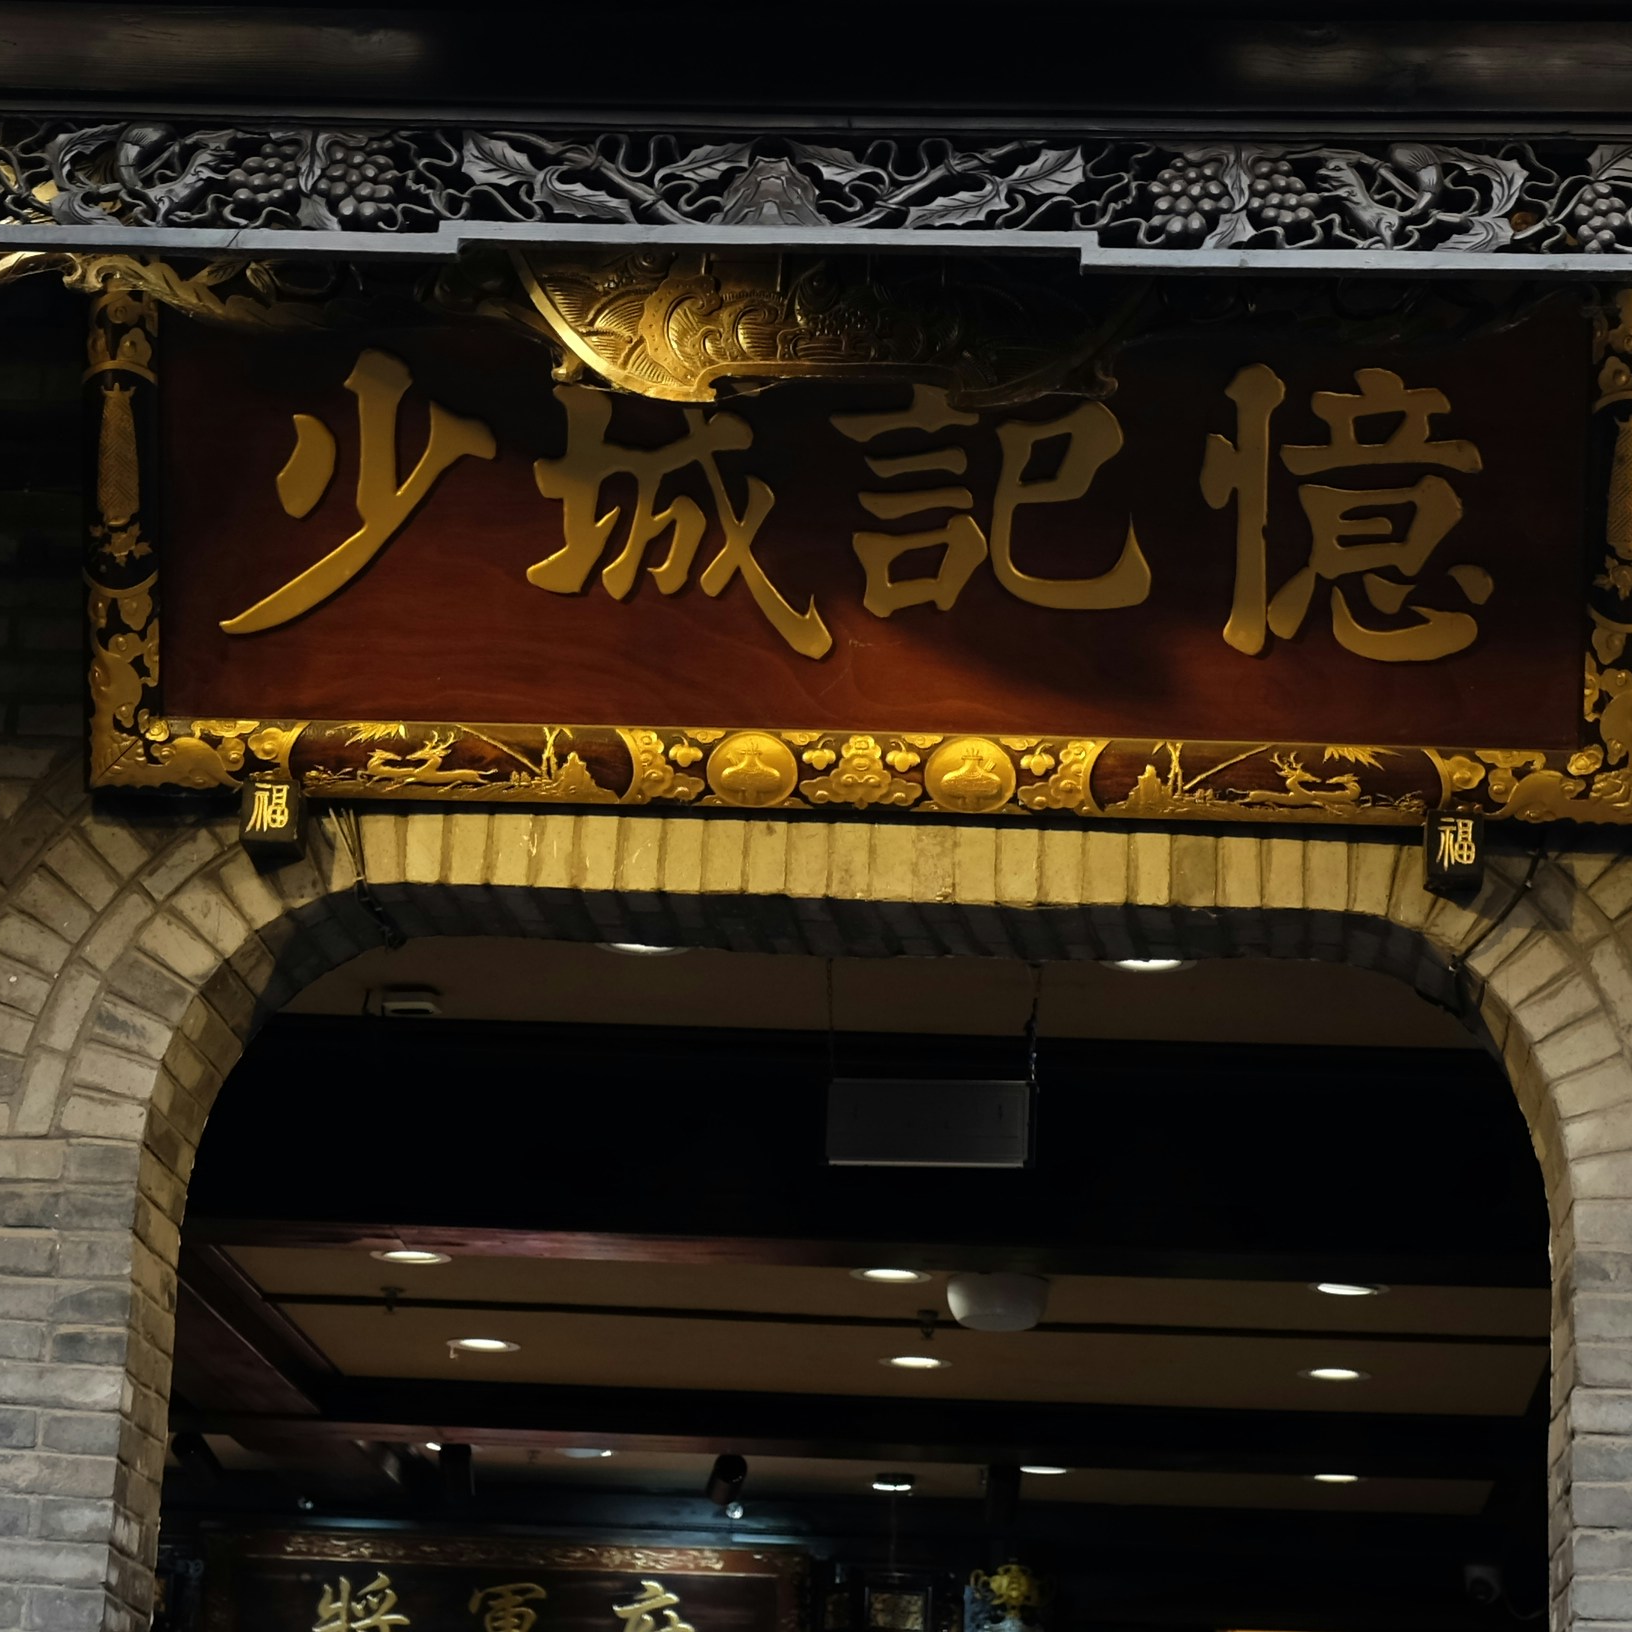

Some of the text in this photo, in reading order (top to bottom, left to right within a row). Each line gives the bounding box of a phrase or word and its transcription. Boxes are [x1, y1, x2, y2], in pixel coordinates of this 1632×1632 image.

[220, 351, 1493, 662] 少城記憶
[245, 783, 290, 832] 福
[1436, 817, 1475, 871] 福
